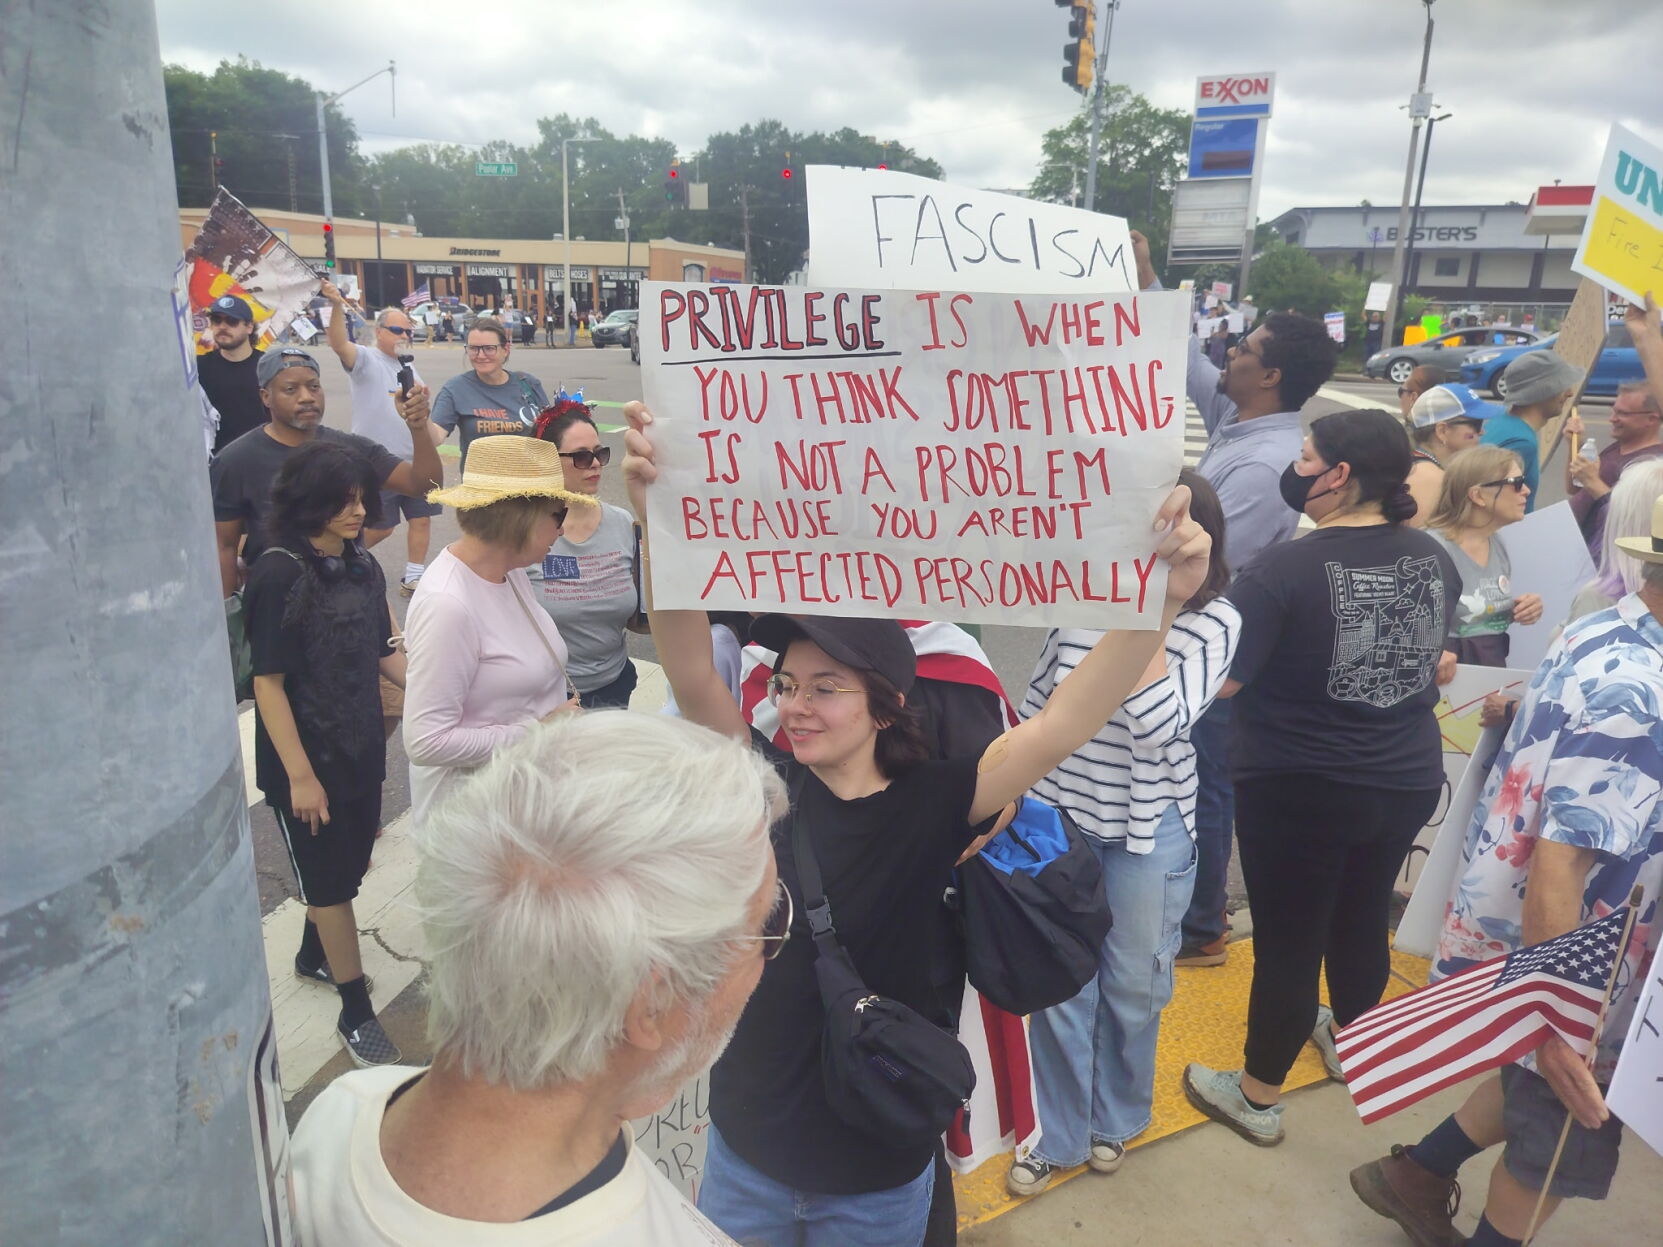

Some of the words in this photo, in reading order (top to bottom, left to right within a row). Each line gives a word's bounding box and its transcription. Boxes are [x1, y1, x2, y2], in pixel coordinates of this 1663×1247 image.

[1200, 77, 1269, 104] EXXON
[872, 194, 1132, 291] FASCISM
[1386, 226, 1478, 241] BSTER'S
[471, 266, 508, 277] ALIGNMENT
[660, 286, 885, 352] PRIVILEGE
[915, 292, 973, 351] IS
[1014, 296, 1141, 347] WHEN
[693, 365, 769, 424] YOU
[783, 365, 920, 425] THINK
[943, 359, 1175, 437] SOMETHING
[477, 420, 523, 434] FRIENDS
[698, 429, 742, 484] IS
[774, 439, 847, 495] NOT
[861, 446, 896, 495] A
[915, 442, 1111, 504] PROBLEM
[682, 496, 839, 541] BECAUSE
[871, 502, 937, 540] YOU
[957, 501, 1092, 540] AREN'T
[544, 557, 578, 577] LOVE
[700, 550, 902, 608] AFFECTED
[914, 552, 1160, 614] PERSONALLY
[1351, 572, 1377, 582] SUMMER
